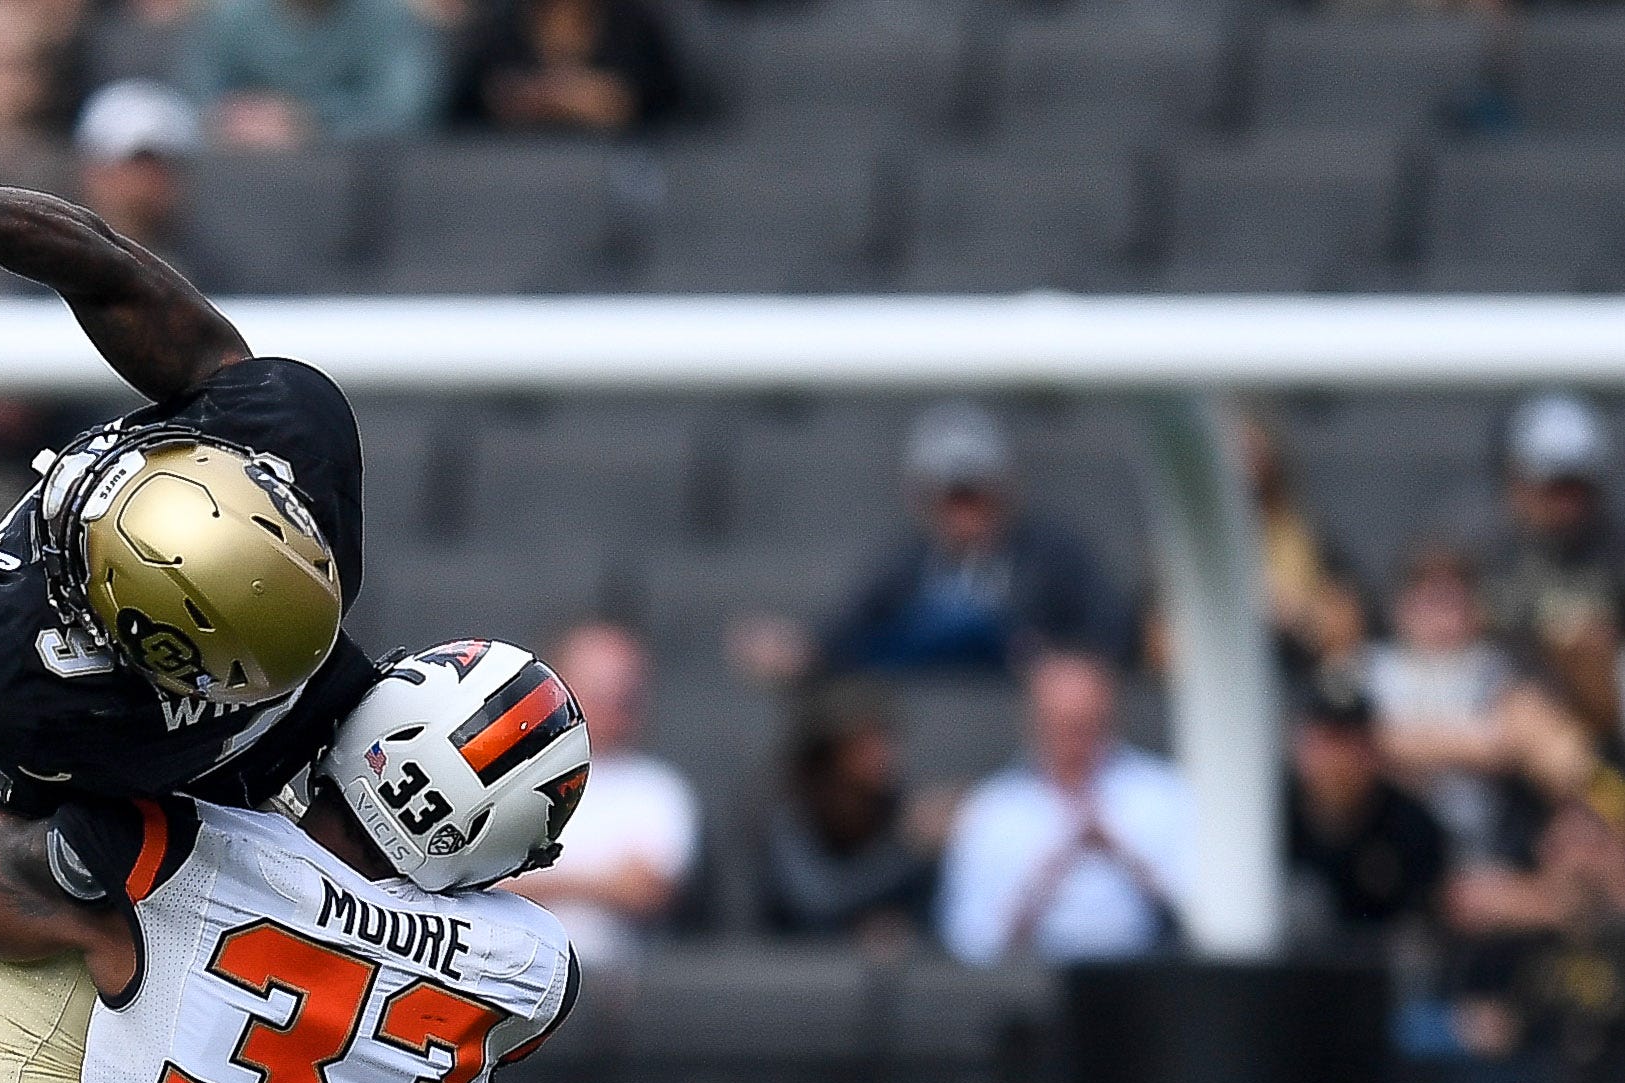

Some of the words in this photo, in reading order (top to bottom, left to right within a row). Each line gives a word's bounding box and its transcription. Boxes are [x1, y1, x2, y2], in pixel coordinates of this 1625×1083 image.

[356, 792, 410, 861] VICIS
[377, 761, 454, 836] 33
[316, 876, 471, 982] MOORE
